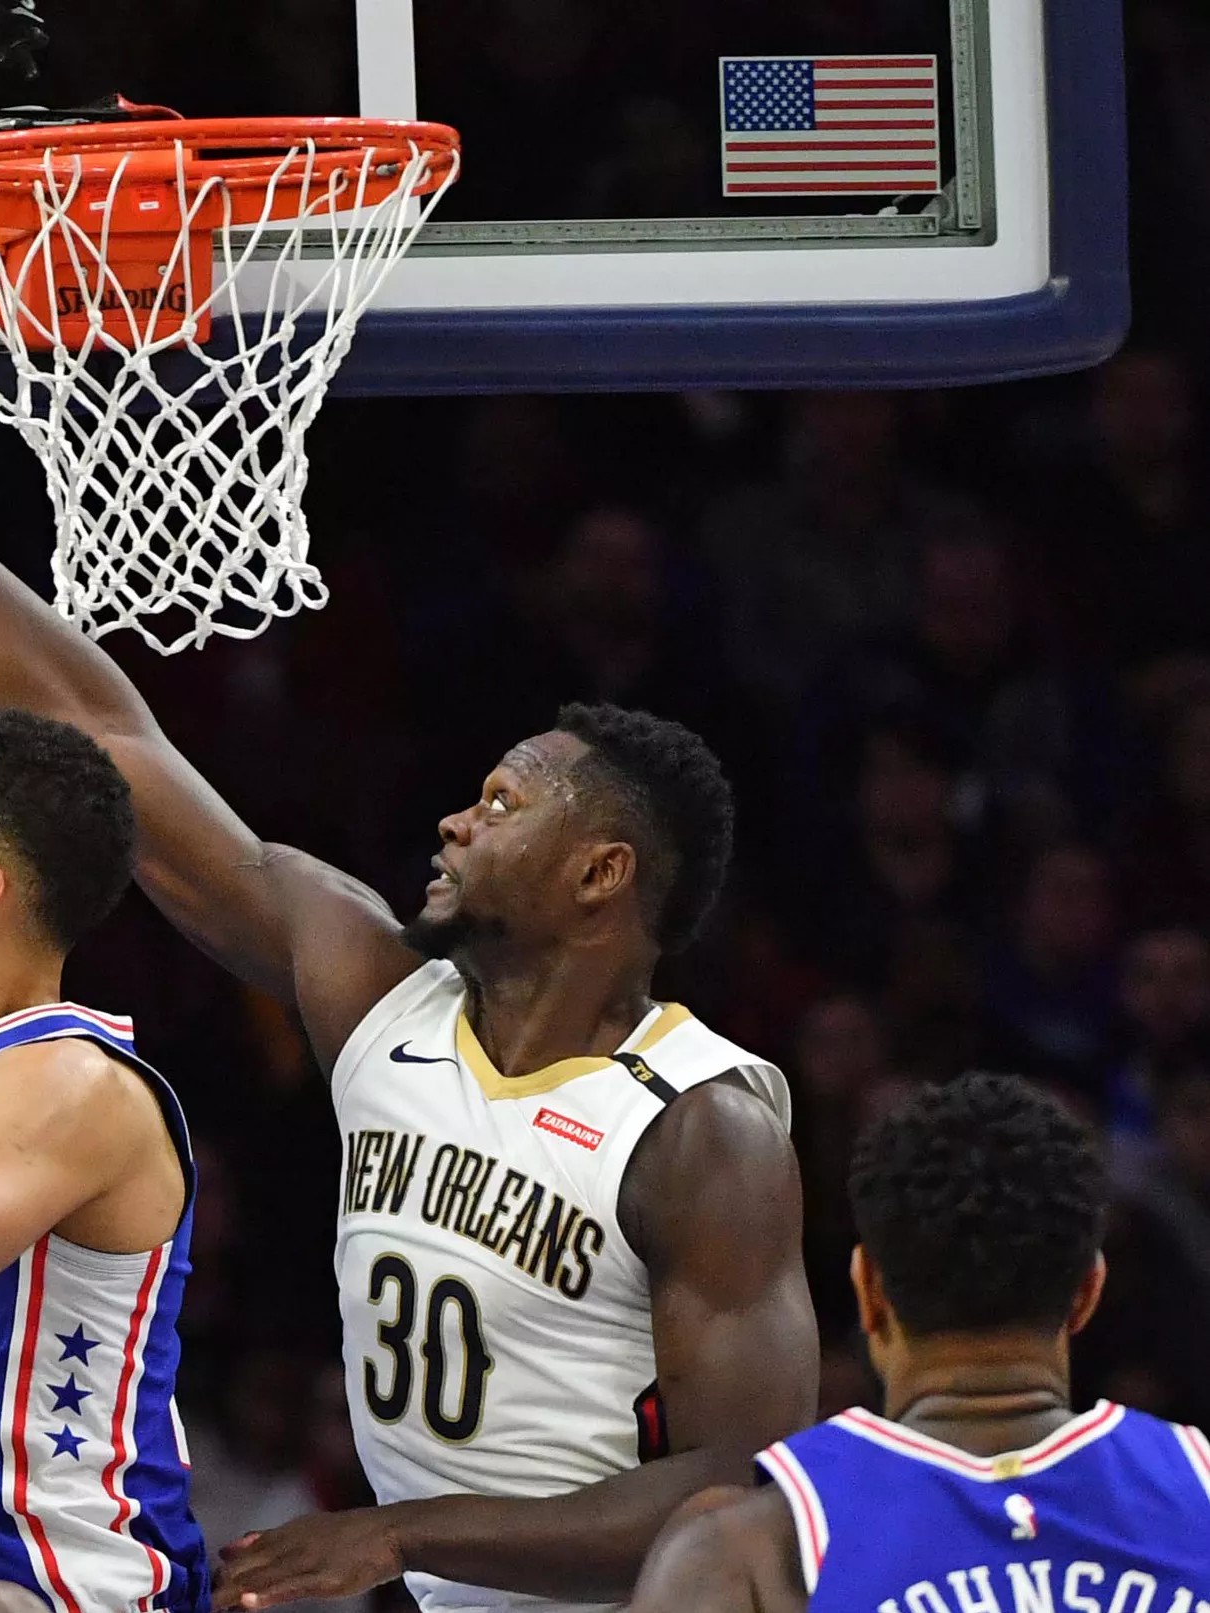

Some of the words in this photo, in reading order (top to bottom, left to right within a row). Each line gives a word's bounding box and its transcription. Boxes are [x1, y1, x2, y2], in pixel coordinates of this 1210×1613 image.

[343, 1130, 426, 1216] NEW
[421, 1143, 606, 1301] ORLEANS
[363, 1251, 495, 1445] 30
[877, 1559, 1210, 1613] HNSO
